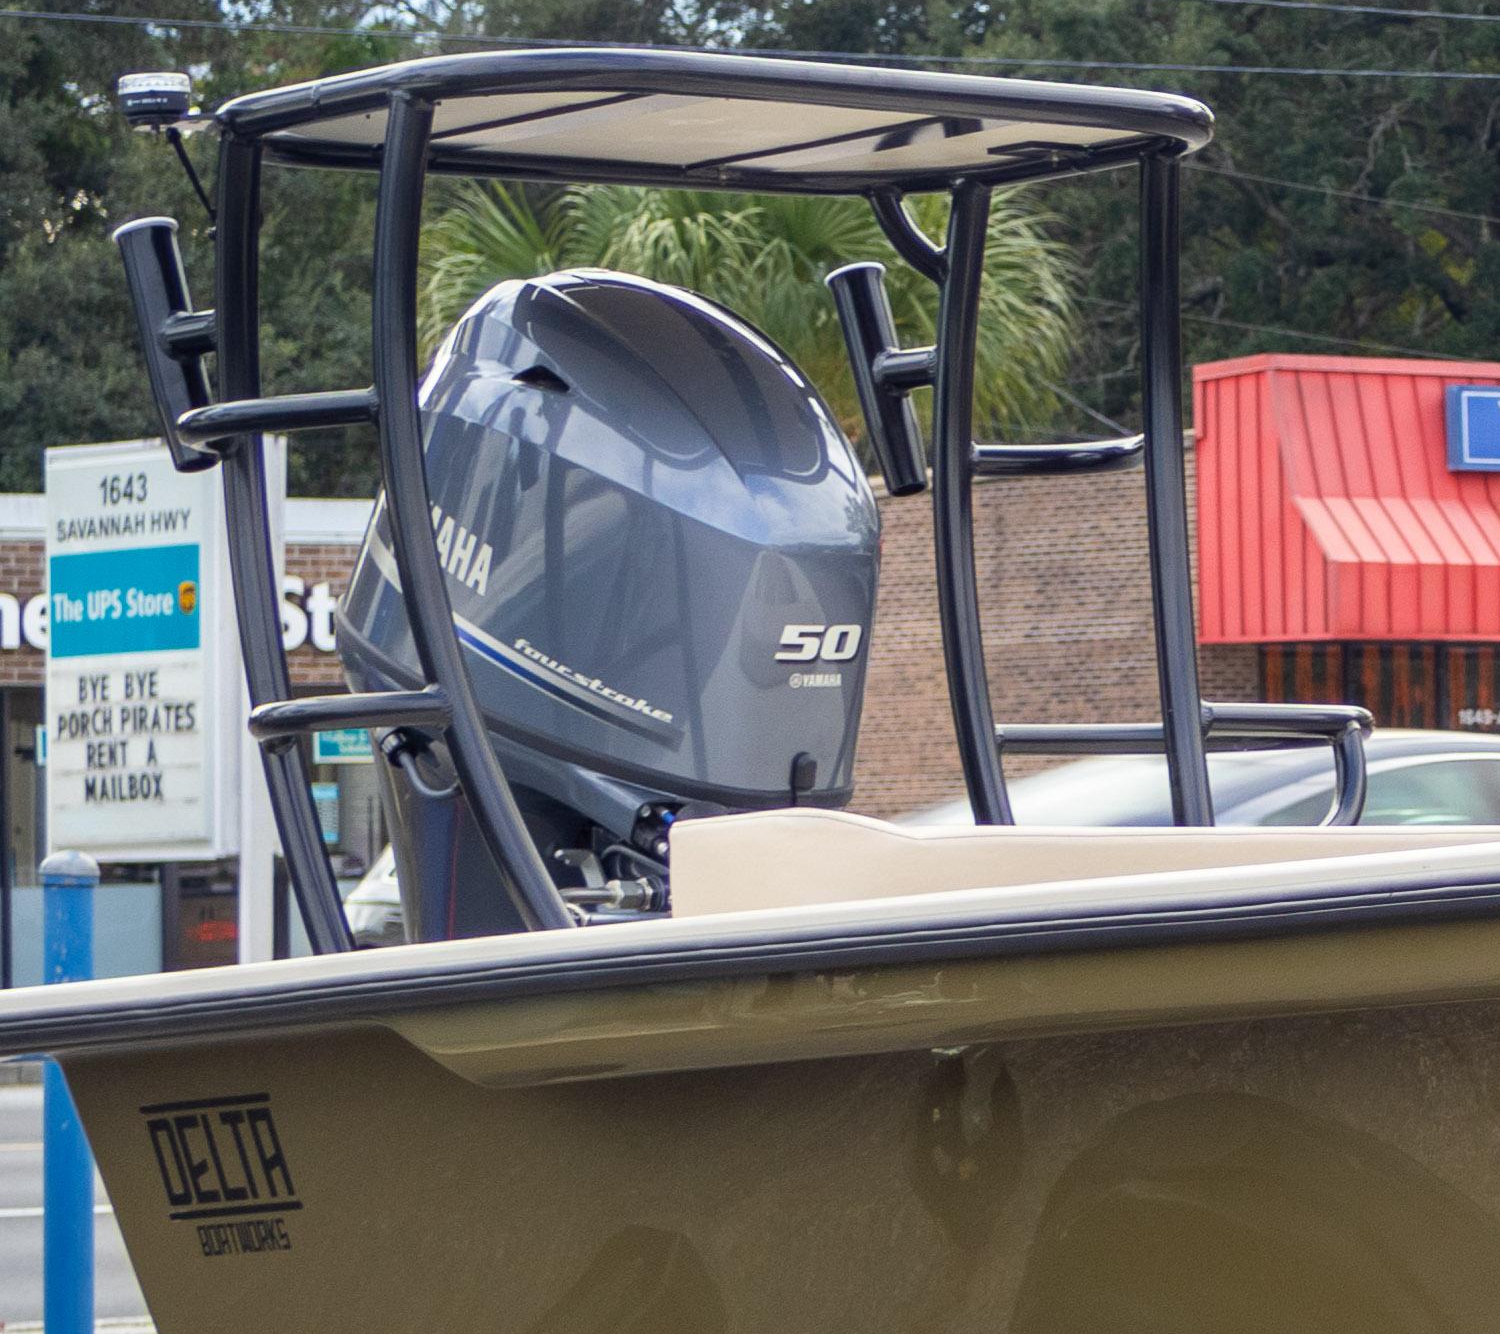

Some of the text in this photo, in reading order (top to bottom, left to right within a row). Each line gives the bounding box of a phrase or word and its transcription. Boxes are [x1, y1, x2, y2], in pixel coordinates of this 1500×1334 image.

[99, 472, 148, 505] 1643
[56, 507, 191, 543] SAVANNAH HWY
[429, 500, 493, 597] AHA
[53, 592, 83, 623] The
[87, 588, 122, 621] UPS
[126, 587, 174, 618] Store
[774, 624, 862, 661] 50
[78, 670, 158, 704] BYE BYE
[803, 673, 842, 688] YAMAHA
[58, 701, 195, 740] PORCH PIRATES
[87, 738, 158, 770] RENT A
[85, 772, 164, 803] MAILBOX
[147, 1107, 295, 1206] DELTA
[197, 1218, 292, 1256] BOATWORKS
